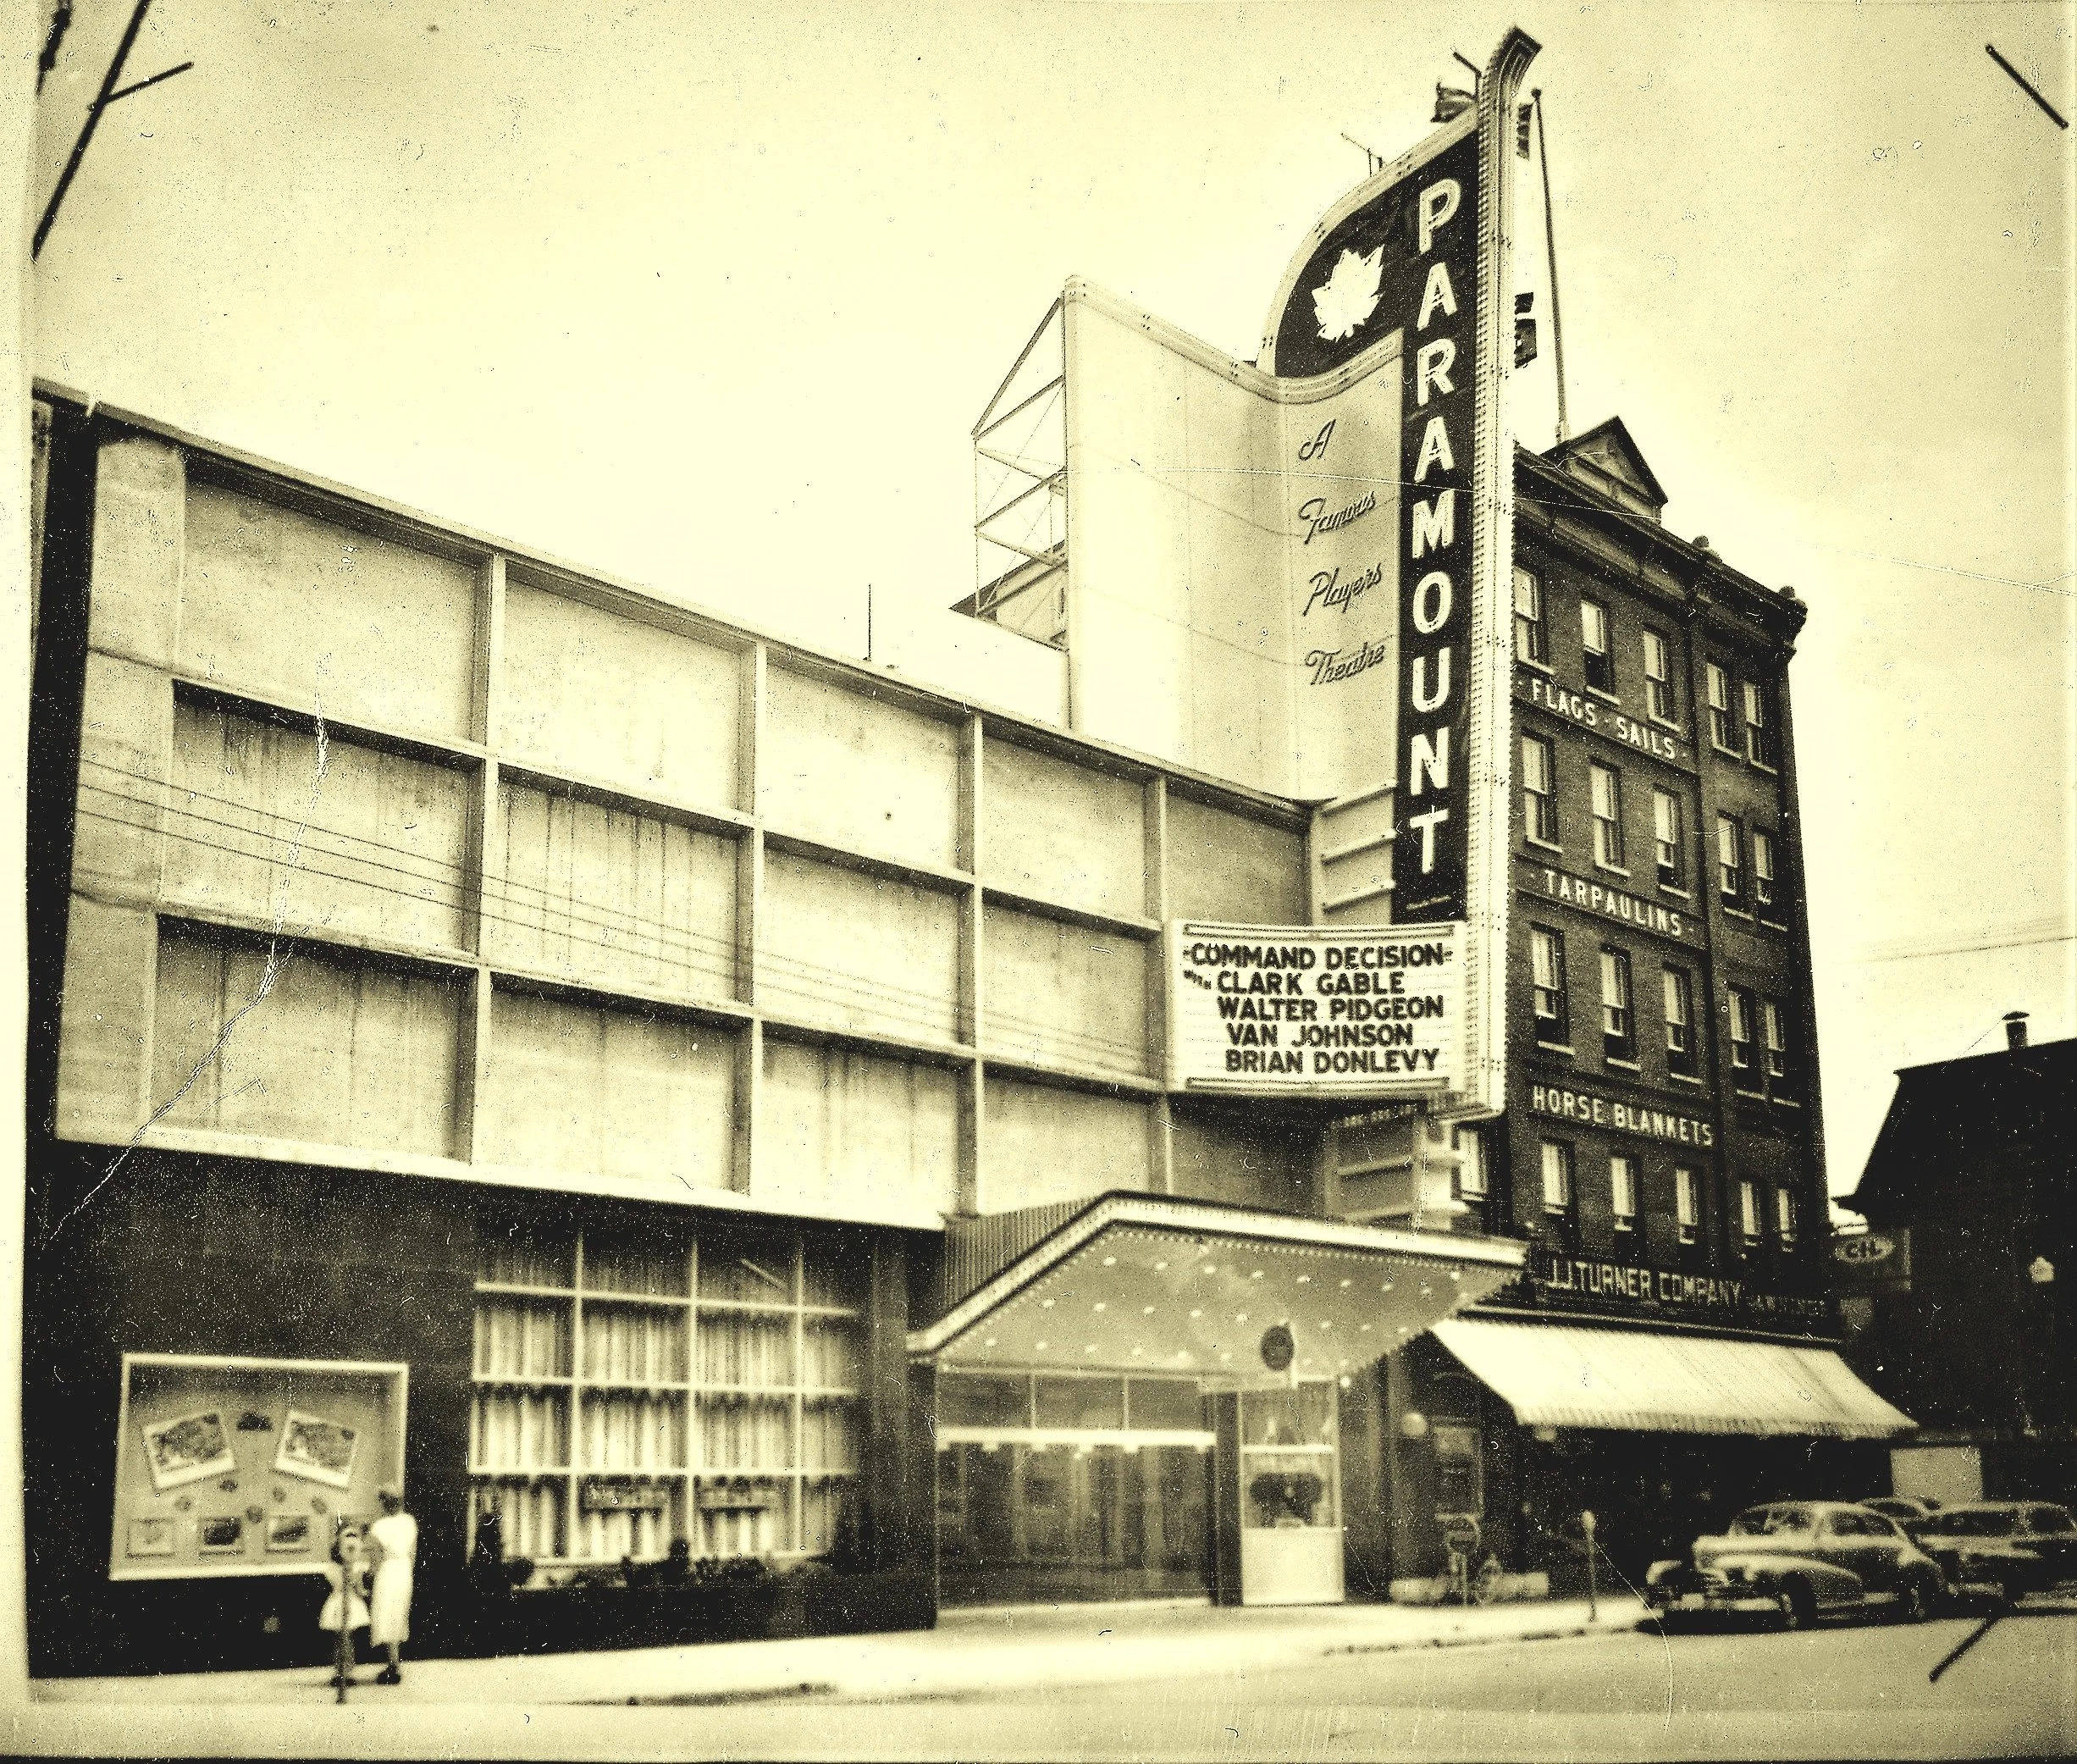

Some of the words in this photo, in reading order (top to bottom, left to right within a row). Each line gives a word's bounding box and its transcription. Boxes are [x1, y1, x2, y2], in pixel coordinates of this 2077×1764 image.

[1298, 418, 1336, 462] A
[1298, 490, 1376, 545] Famous
[1409, 176, 1461, 874] PARAMOUNT
[1302, 562, 1382, 617] Players
[1305, 641, 1385, 685] Theatre
[1532, 678, 1597, 726] FLAGS
[1616, 716, 1676, 760] SAILS
[1545, 869, 1682, 937] TARPAULINS
[1190, 943, 1316, 970] COMMAND
[1325, 943, 1443, 970] DECISION
[1217, 970, 1303, 995] CLARK
[1317, 970, 1406, 996] GABLE
[1217, 995, 1317, 1022] WALTER
[1329, 995, 1444, 1021] PIDGEON
[1226, 1022, 1278, 1047] VAN
[1290, 1023, 1413, 1048] JOHNSON
[1225, 1048, 1303, 1074] BRIAN
[1313, 1048, 1439, 1074] DONLEVY
[1532, 1086, 1605, 1125] HORSE
[1613, 1104, 1713, 1147] BLANKETS
[1575, 1261, 1651, 1298] TURNER
[1659, 1270, 1741, 1306] COMPANY
